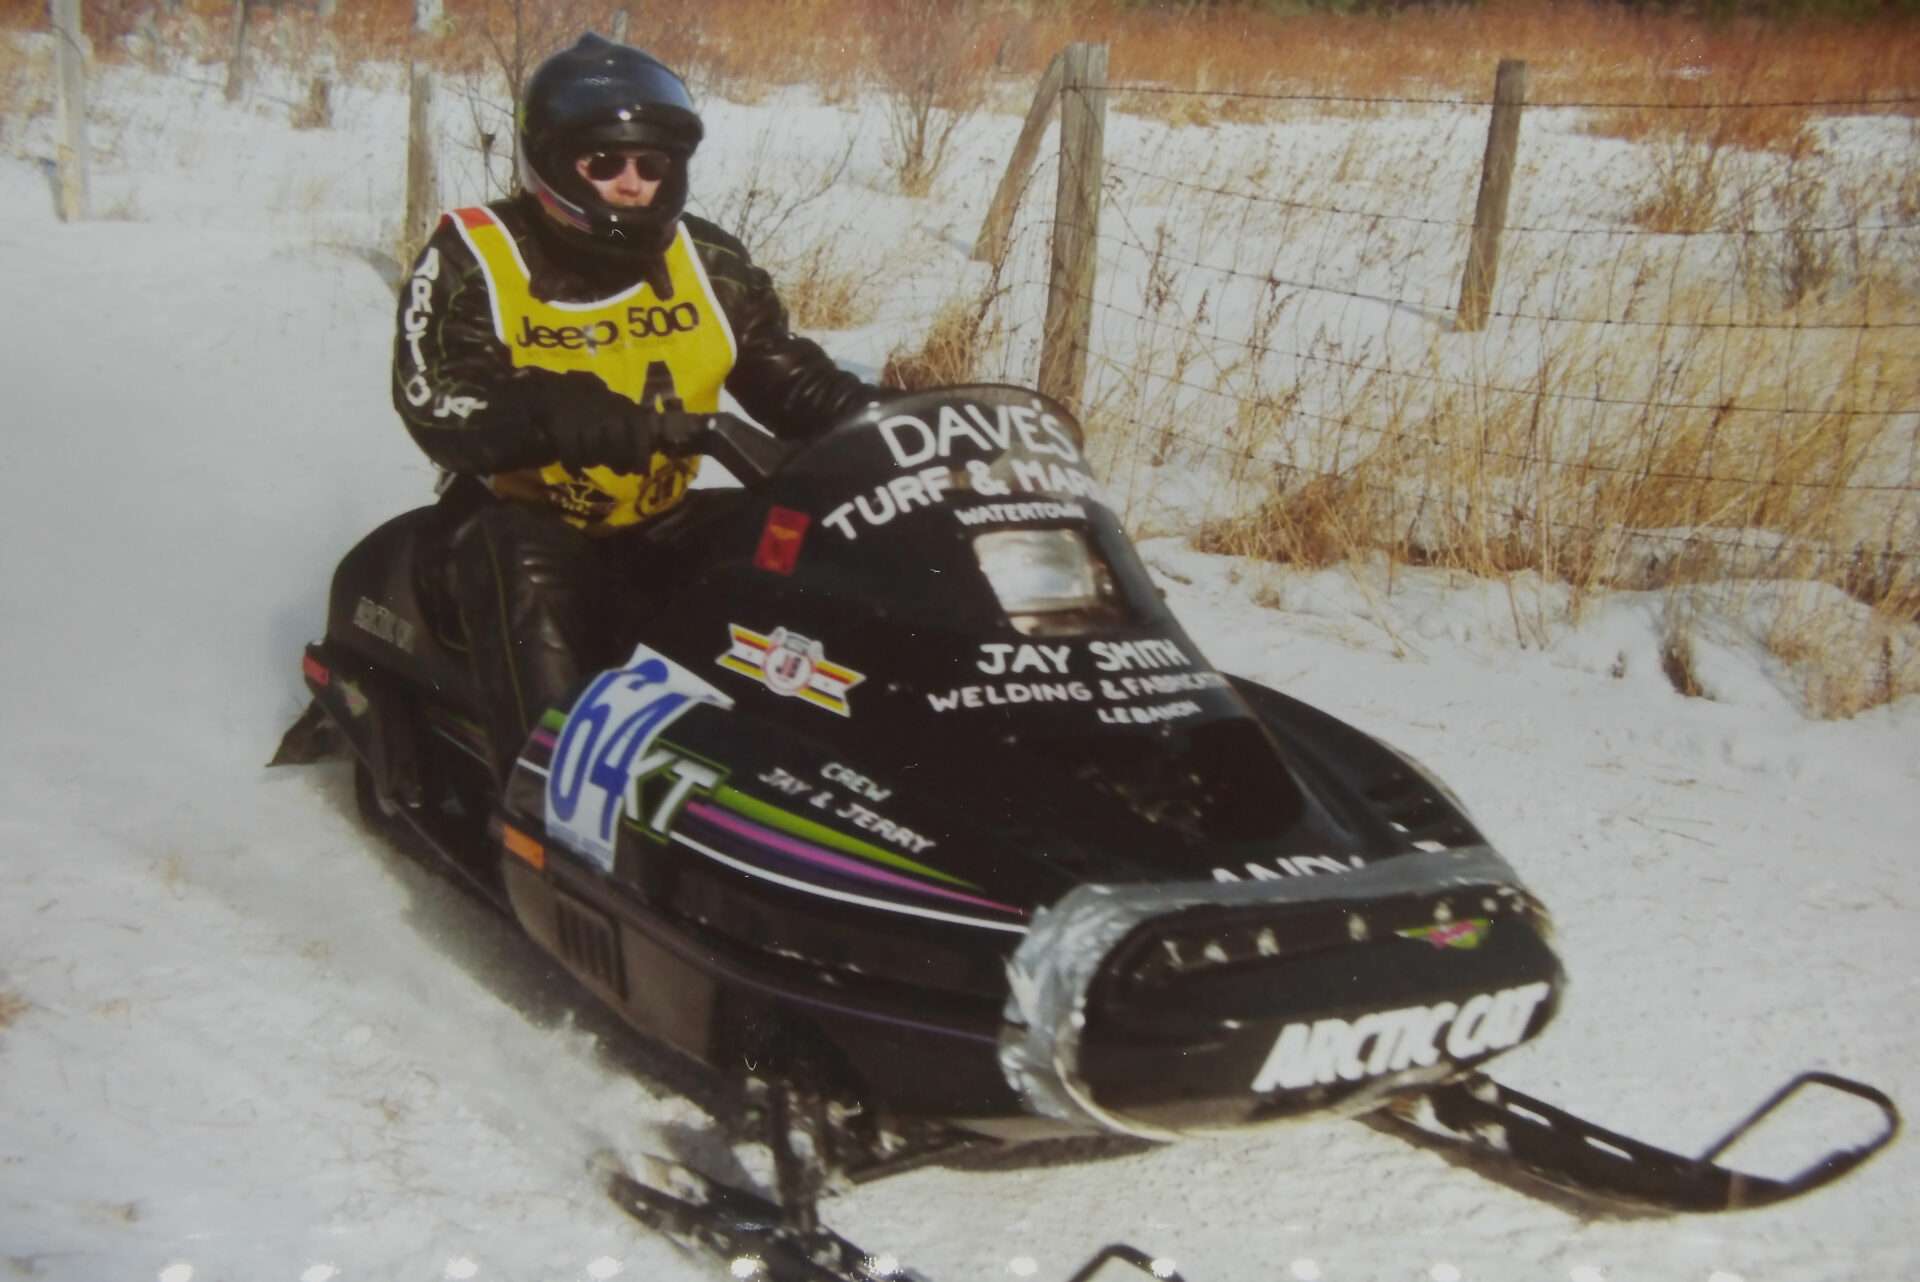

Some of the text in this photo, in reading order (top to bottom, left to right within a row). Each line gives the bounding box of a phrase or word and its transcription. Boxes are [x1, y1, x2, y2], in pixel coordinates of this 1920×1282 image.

[517, 303, 699, 357] Jeep 500
[878, 400, 1079, 468] DAVE'S
[822, 466, 949, 540] TURF
[966, 459, 1021, 496] &
[976, 640, 1191, 675] JAY SMITH
[926, 682, 1093, 712] WELDING
[757, 767, 813, 795] JAY
[835, 802, 937, 854] JERRY
[820, 763, 892, 802] CREW
[1251, 981, 1550, 1093] ARCTIC CAT
